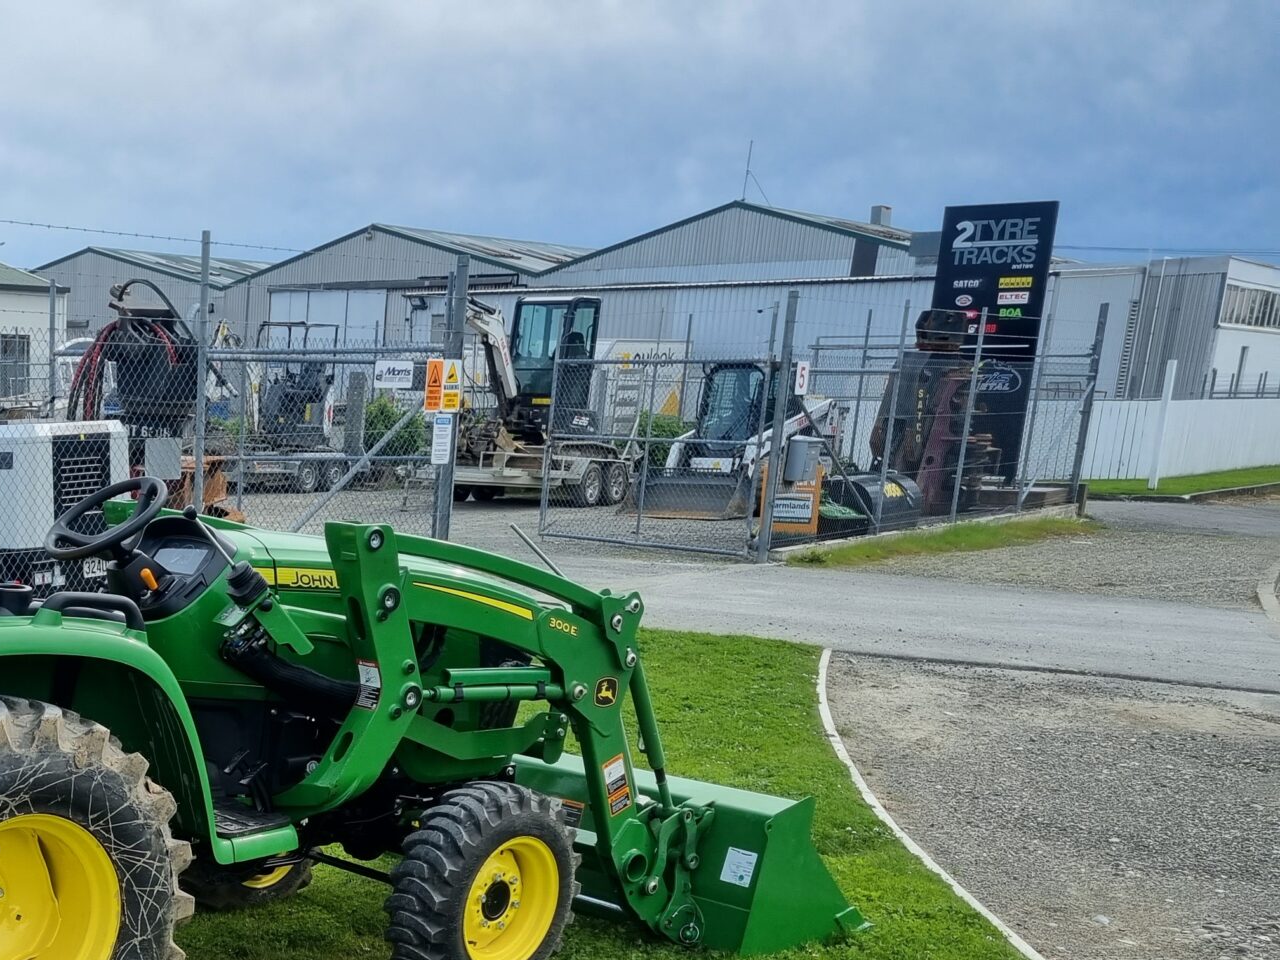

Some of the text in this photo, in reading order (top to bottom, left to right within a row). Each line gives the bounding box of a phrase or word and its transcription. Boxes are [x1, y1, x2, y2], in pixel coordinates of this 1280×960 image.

[952, 246, 1037, 265] TRACKS
[953, 280, 980, 288] SATCO
[999, 308, 1022, 317] BOA
[798, 366, 806, 389] 5
[774, 501, 810, 511] armlands
[291, 571, 334, 587] JOHN
